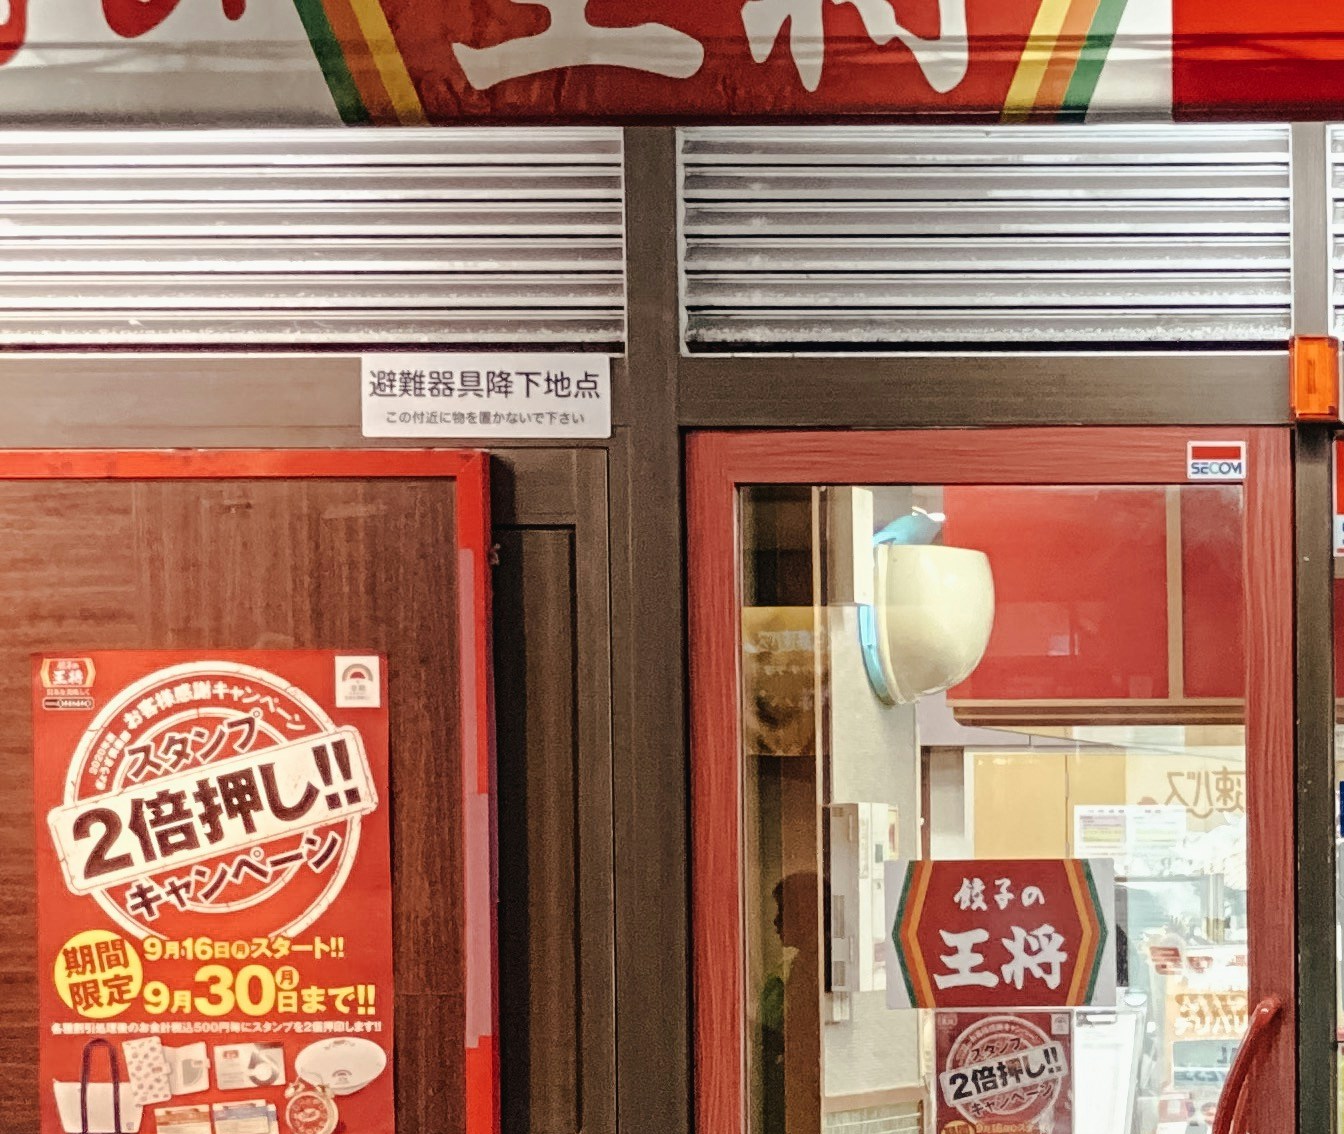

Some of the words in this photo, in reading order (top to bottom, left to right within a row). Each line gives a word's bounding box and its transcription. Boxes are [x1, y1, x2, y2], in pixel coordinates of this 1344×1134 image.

[369, 370, 600, 399] 避難器具降下地点
[386, 411, 584, 424] この付近に物を置かないで下さい
[1191, 461, 1242, 475] SECOM
[123, 680, 306, 731] お客様感謝キャンペーン
[127, 709, 263, 781] スタンプ
[73, 738, 362, 880] 2倍押し!!
[129, 831, 341, 921] キャンペーン
[953, 877, 1045, 911] 餃子の
[63, 938, 130, 977] 期間
[933, 922, 1068, 990] 王将
[69, 975, 134, 1013] 限定
[949, 1046, 1062, 1101] 2倍押し!!
